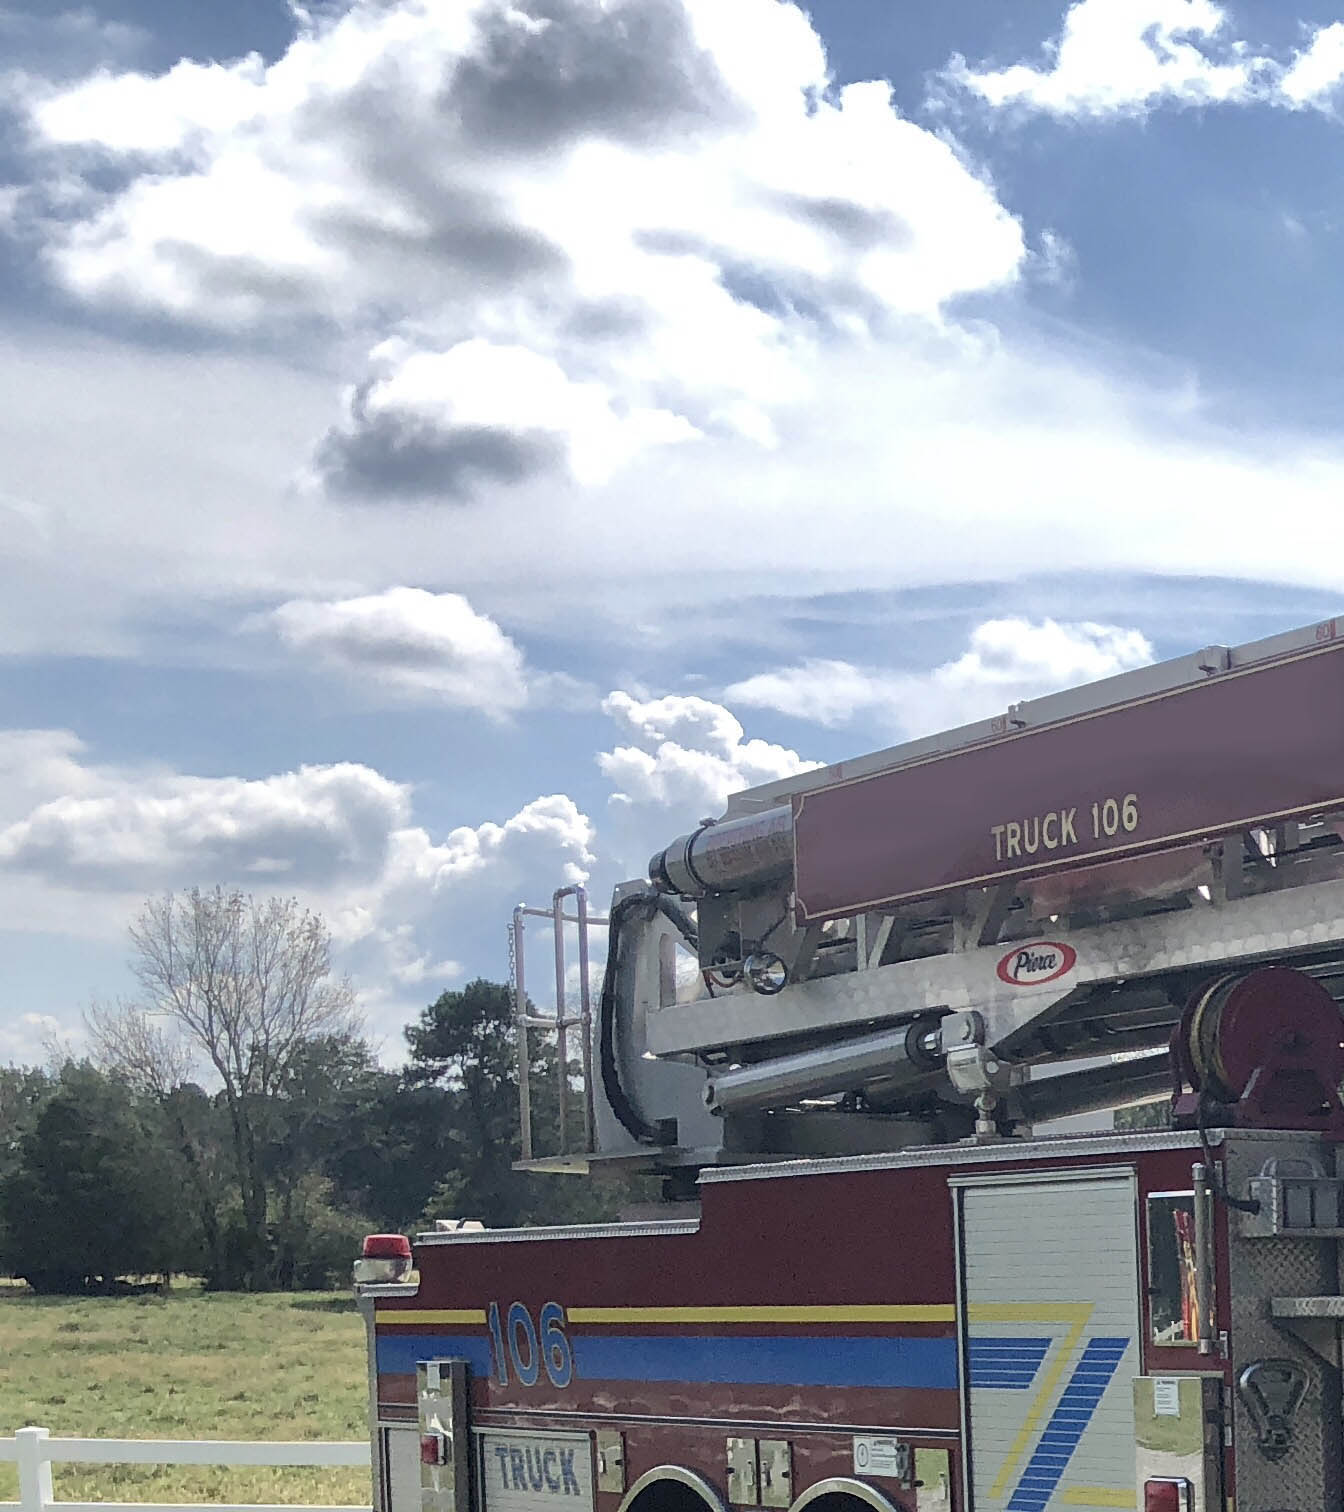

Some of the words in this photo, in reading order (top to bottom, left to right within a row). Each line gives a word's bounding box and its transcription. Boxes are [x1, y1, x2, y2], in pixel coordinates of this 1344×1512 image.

[991, 807, 1078, 860] TRUCK
[1092, 793, 1138, 839] 106
[1013, 951, 1057, 979] Pierce
[488, 1301, 572, 1388] 106
[494, 1447, 580, 1496] TRUCK
